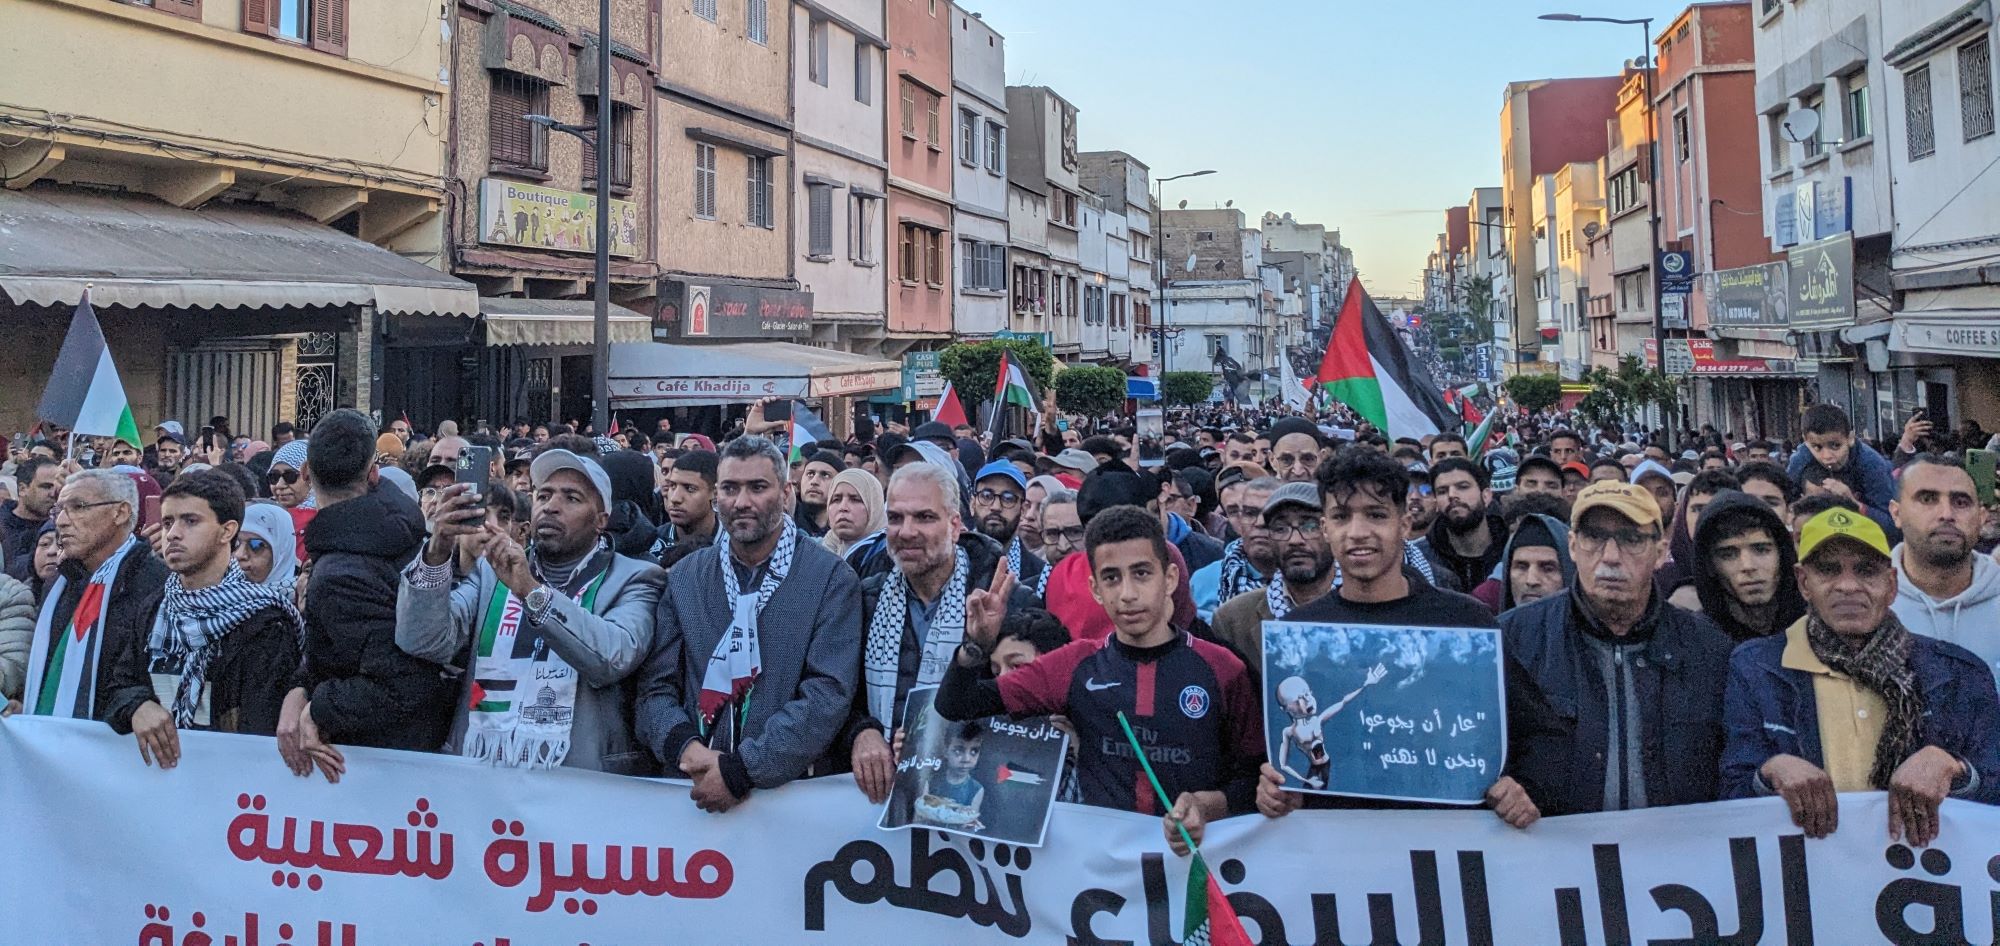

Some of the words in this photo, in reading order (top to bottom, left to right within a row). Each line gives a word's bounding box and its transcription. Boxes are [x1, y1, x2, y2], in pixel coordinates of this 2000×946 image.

[507, 187, 568, 207] Boutique
[1946, 328, 1986, 345] COFFEE
[1990, 329, 2000, 345] S
[656, 380, 688, 392] Café
[694, 380, 751, 393] Khadija
[840, 376, 853, 388] Café
[1185, 688, 1204, 697] PARIS
[989, 716, 1028, 737] يجوعوا
[1422, 708, 1442, 733] أن
[1029, 723, 1045, 739] أن
[1043, 726, 1061, 741] عار
[1102, 736, 1191, 765] Emates
[1425, 747, 1437, 766] لا
[916, 756, 942, 771] ونحن
[1444, 753, 1486, 775] ونحن
[227, 793, 454, 891] شعبية
[482, 818, 734, 916] مسيرة
[804, 828, 1032, 938] تنظم
